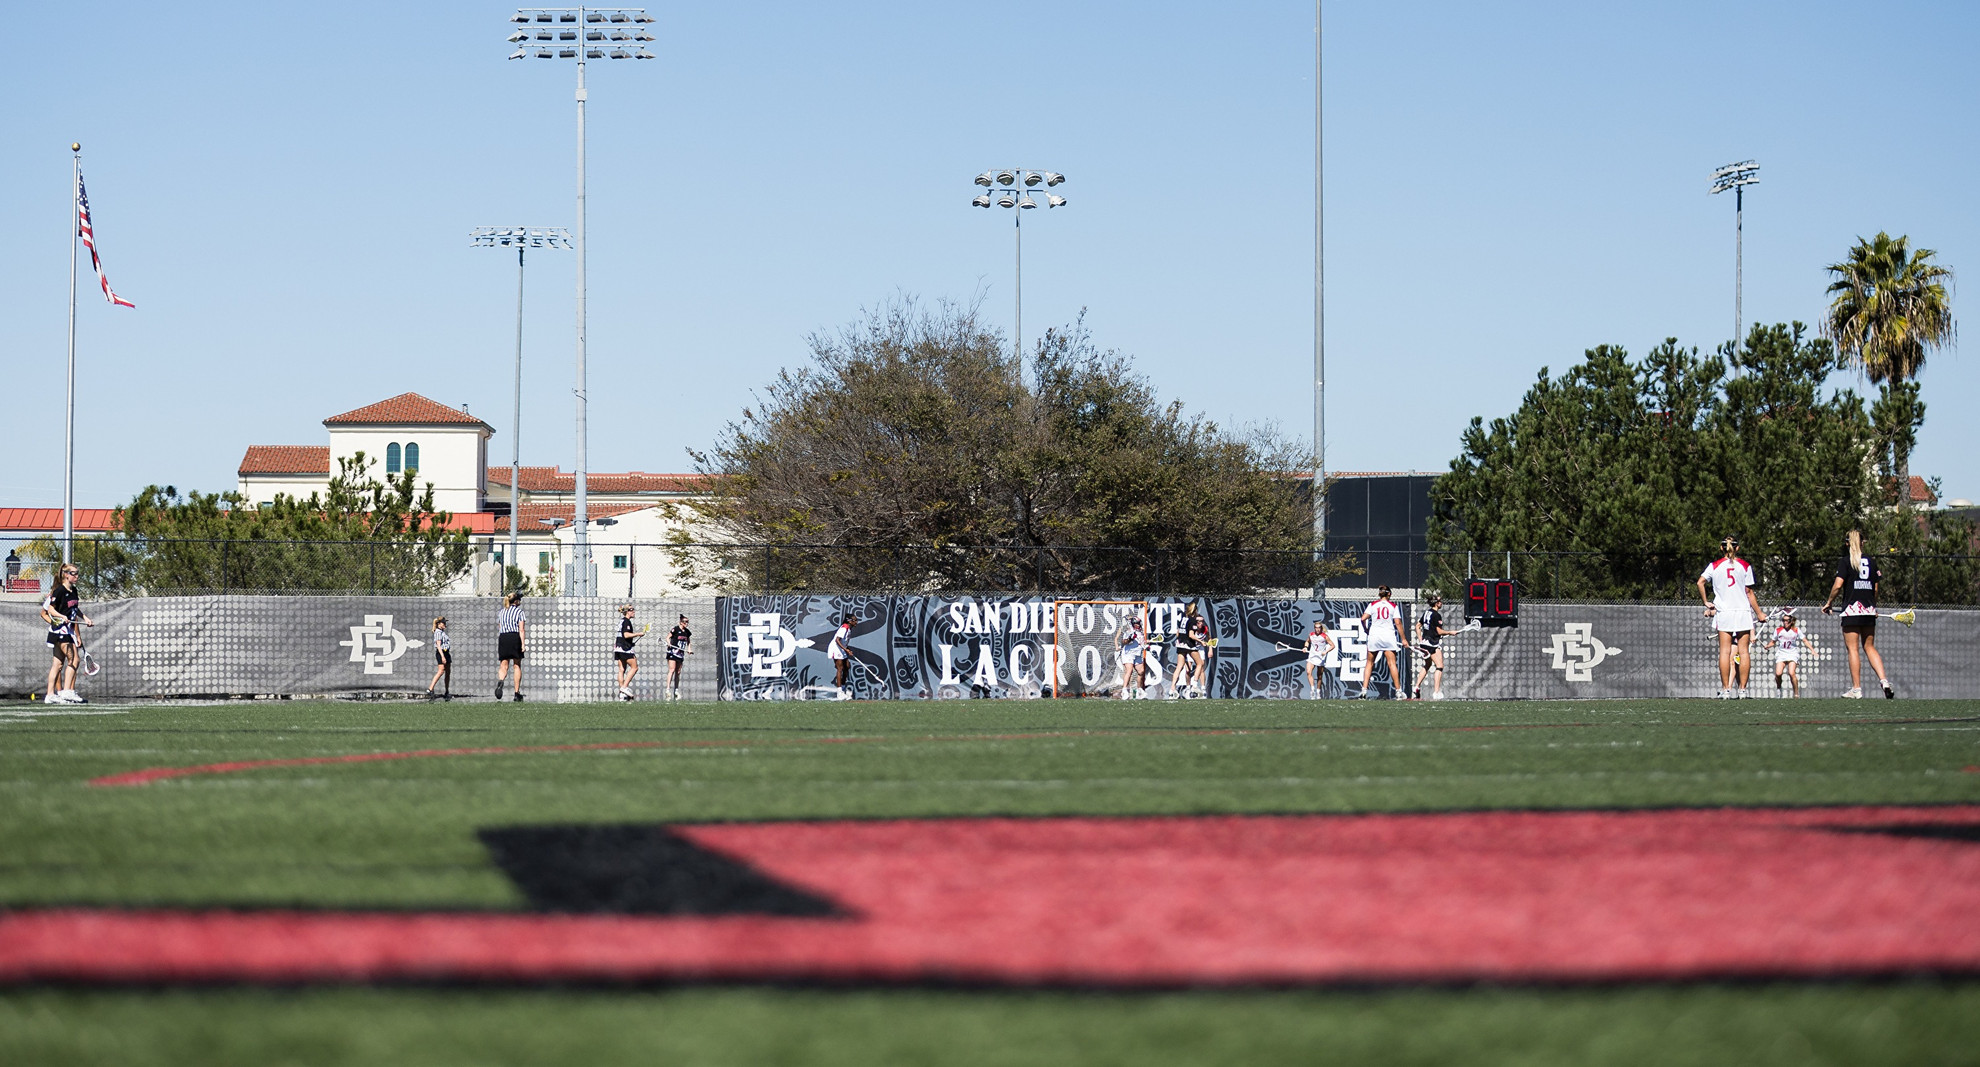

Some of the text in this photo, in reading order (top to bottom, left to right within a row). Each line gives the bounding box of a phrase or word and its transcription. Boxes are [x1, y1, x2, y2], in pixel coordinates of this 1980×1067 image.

[1726, 567, 1736, 587] 5
[1859, 557, 1870, 580] 6
[1470, 582, 1513, 615] 90
[949, 602, 1001, 634] SAN
[1009, 602, 1095, 634] DIEGO
[1376, 606, 1390, 620] 10
